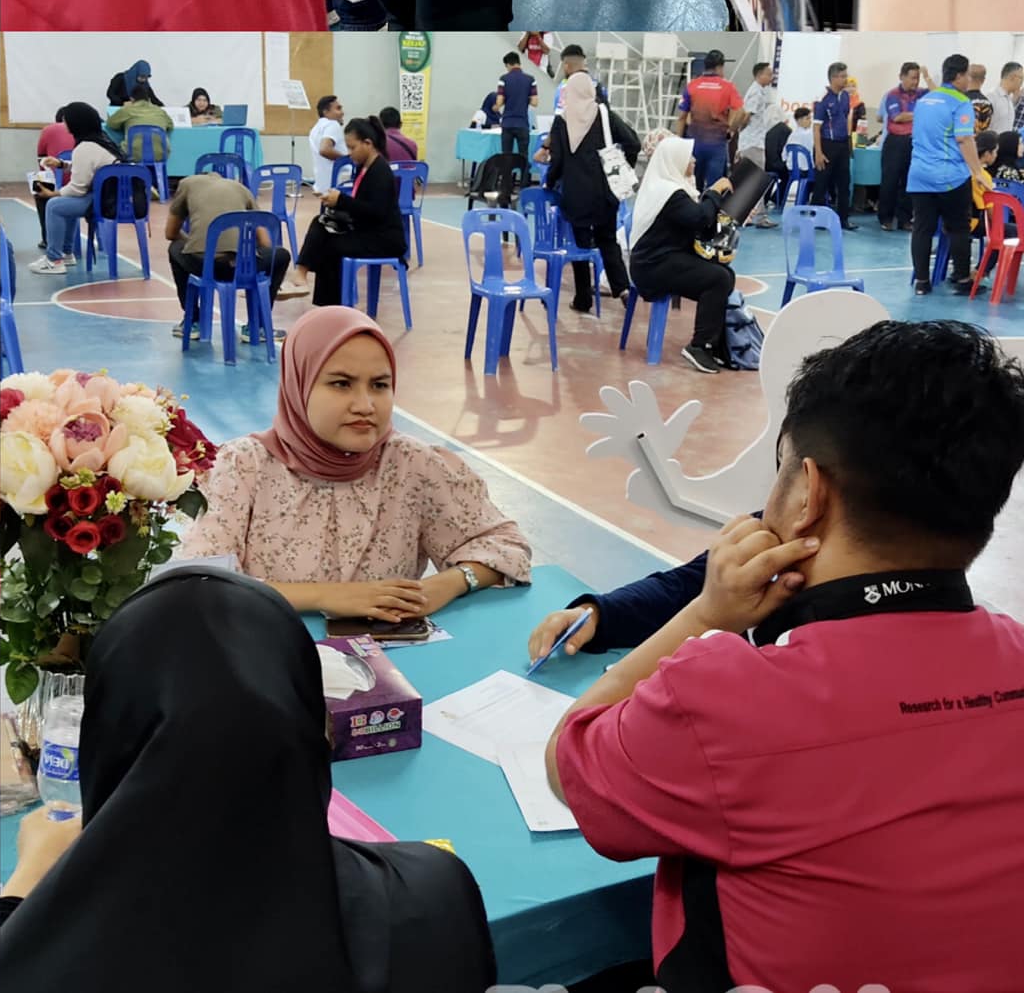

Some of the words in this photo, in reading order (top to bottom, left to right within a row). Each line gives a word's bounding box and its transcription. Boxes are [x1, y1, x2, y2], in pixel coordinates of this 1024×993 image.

[899, 698, 943, 714] Research
[942, 697, 954, 710] for
[963, 694, 993, 709] Healthy
